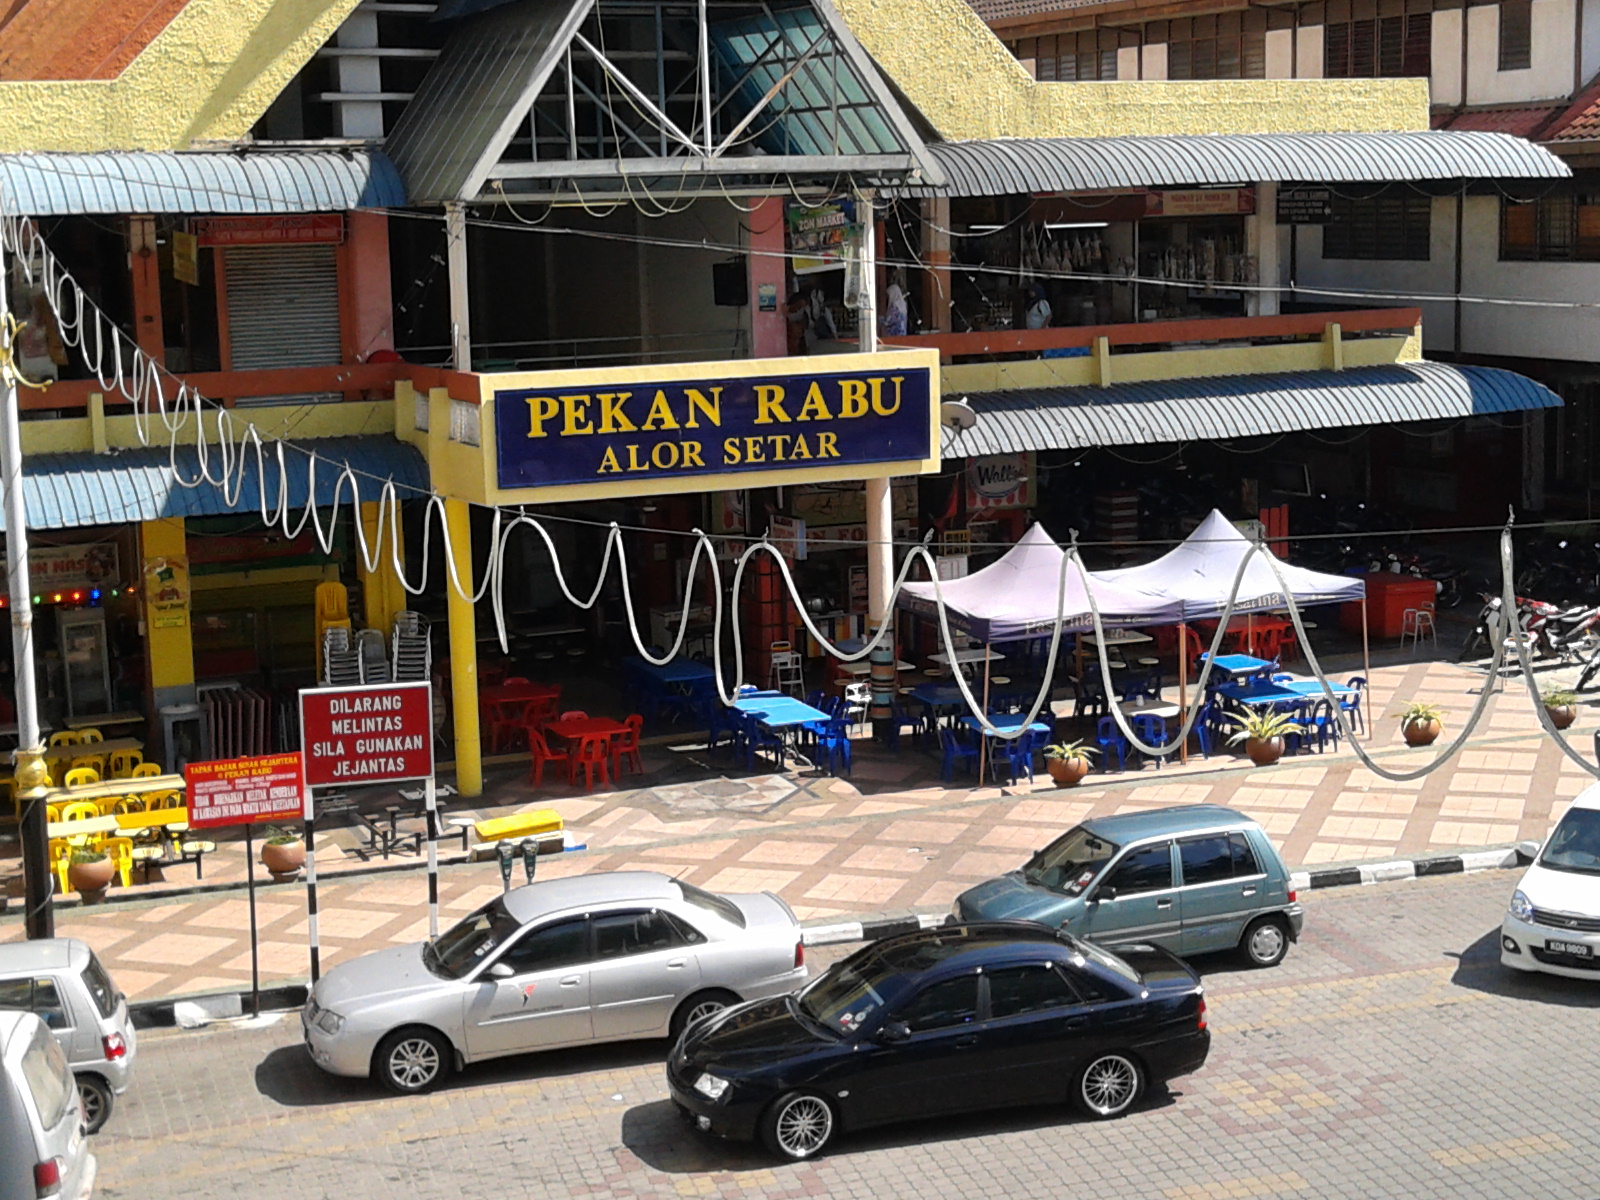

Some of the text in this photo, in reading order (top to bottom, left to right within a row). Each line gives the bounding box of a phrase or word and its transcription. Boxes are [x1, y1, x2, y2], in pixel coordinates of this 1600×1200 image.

[798, 212, 845, 231] ZON MARKET
[525, 376, 905, 438] PEKAN RABU
[597, 432, 841, 474] ALOR SETAR
[330, 696, 402, 715] DILARANG
[332, 716, 402, 736] MELINTAS
[313, 735, 423, 758] SILA GUNAKAN
[190, 765, 213, 775] TAPAK
[214, 763, 238, 773] BAZAR
[224, 769, 250, 779] PEKAN
[251, 767, 273, 776] RABU
[333, 757, 405, 777] JEJANTAS
